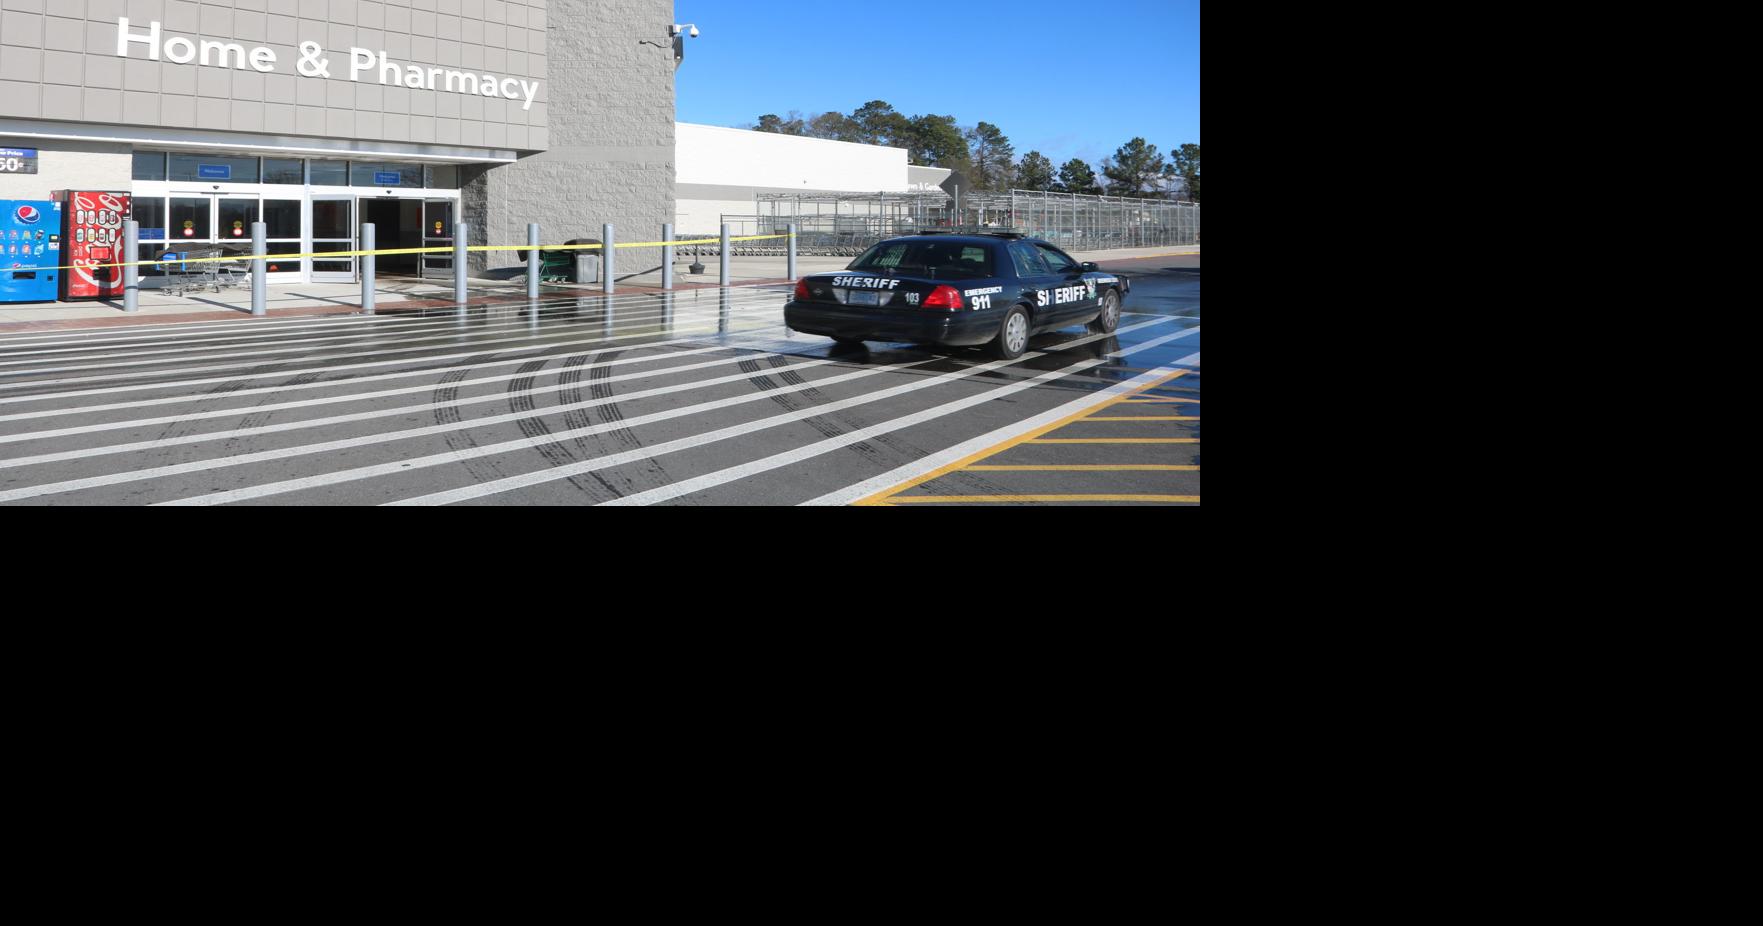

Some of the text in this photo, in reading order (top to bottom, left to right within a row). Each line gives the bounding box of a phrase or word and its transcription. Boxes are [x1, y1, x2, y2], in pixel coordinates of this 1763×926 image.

[117, 16, 539, 111] Home & Pharmacy
[832, 276, 901, 290] SHERIFF
[905, 292, 920, 303] 103
[964, 286, 1003, 297] EMERGENCY
[1037, 285, 1086, 307] SHERIFF
[971, 294, 991, 311] 911
